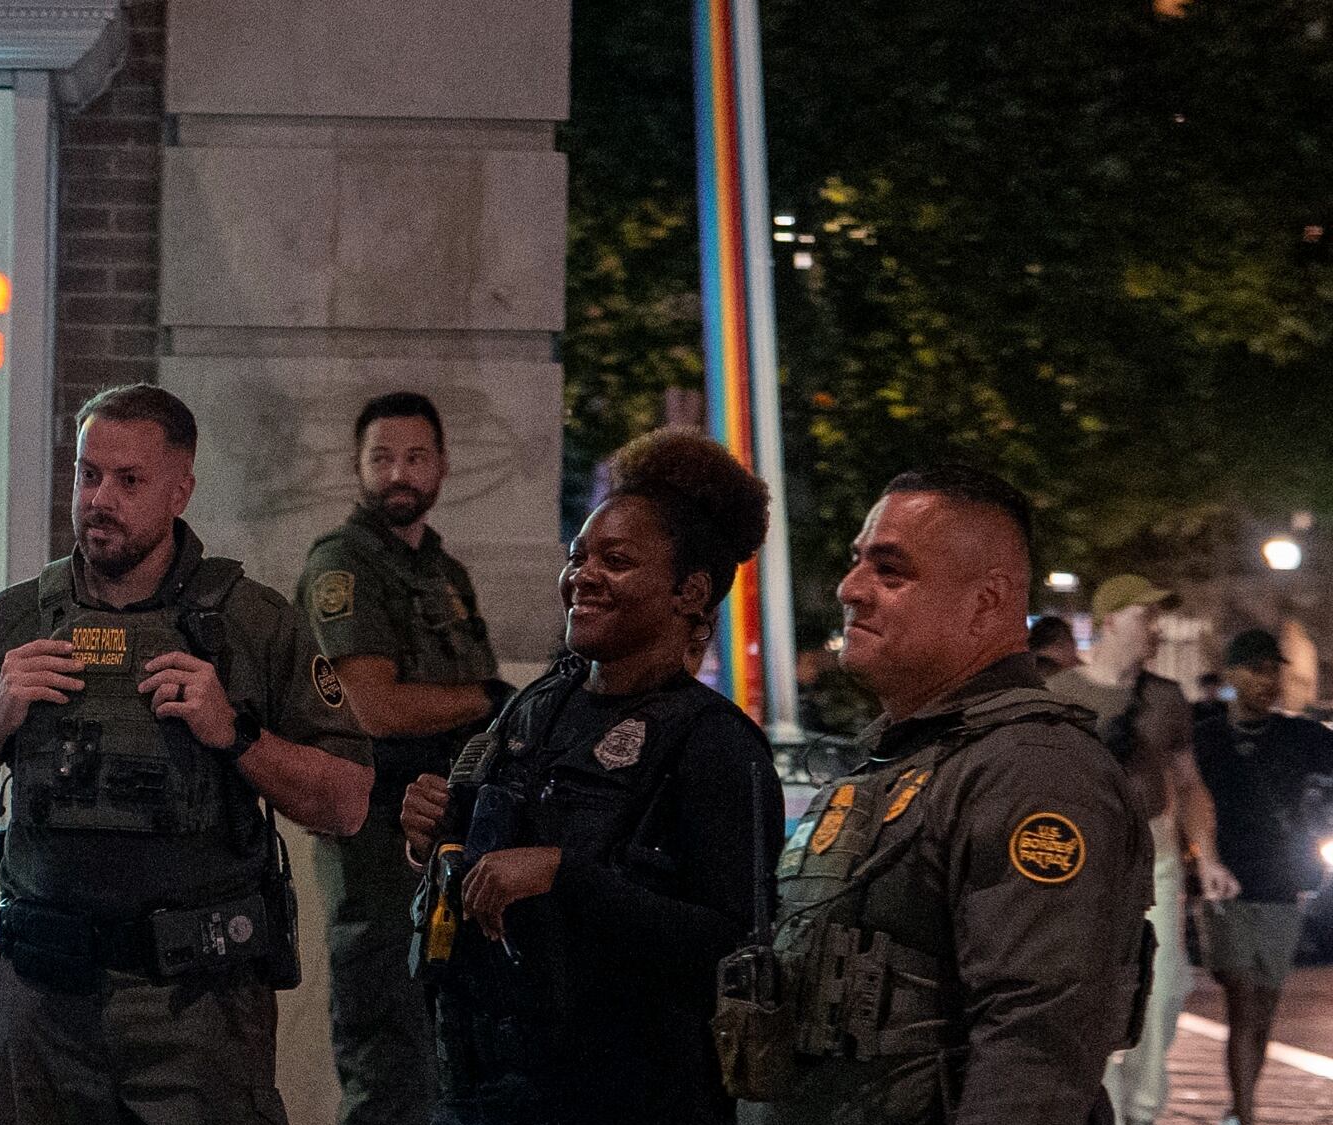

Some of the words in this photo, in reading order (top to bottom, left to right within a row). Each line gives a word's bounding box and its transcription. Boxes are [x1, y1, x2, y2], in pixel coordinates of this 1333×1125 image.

[73, 627, 101, 650] BORDER
[101, 627, 127, 651] PATROL
[101, 653, 125, 665] AGENT
[1020, 838, 1074, 855] BORDER
[1020, 850, 1069, 865] PATROL
